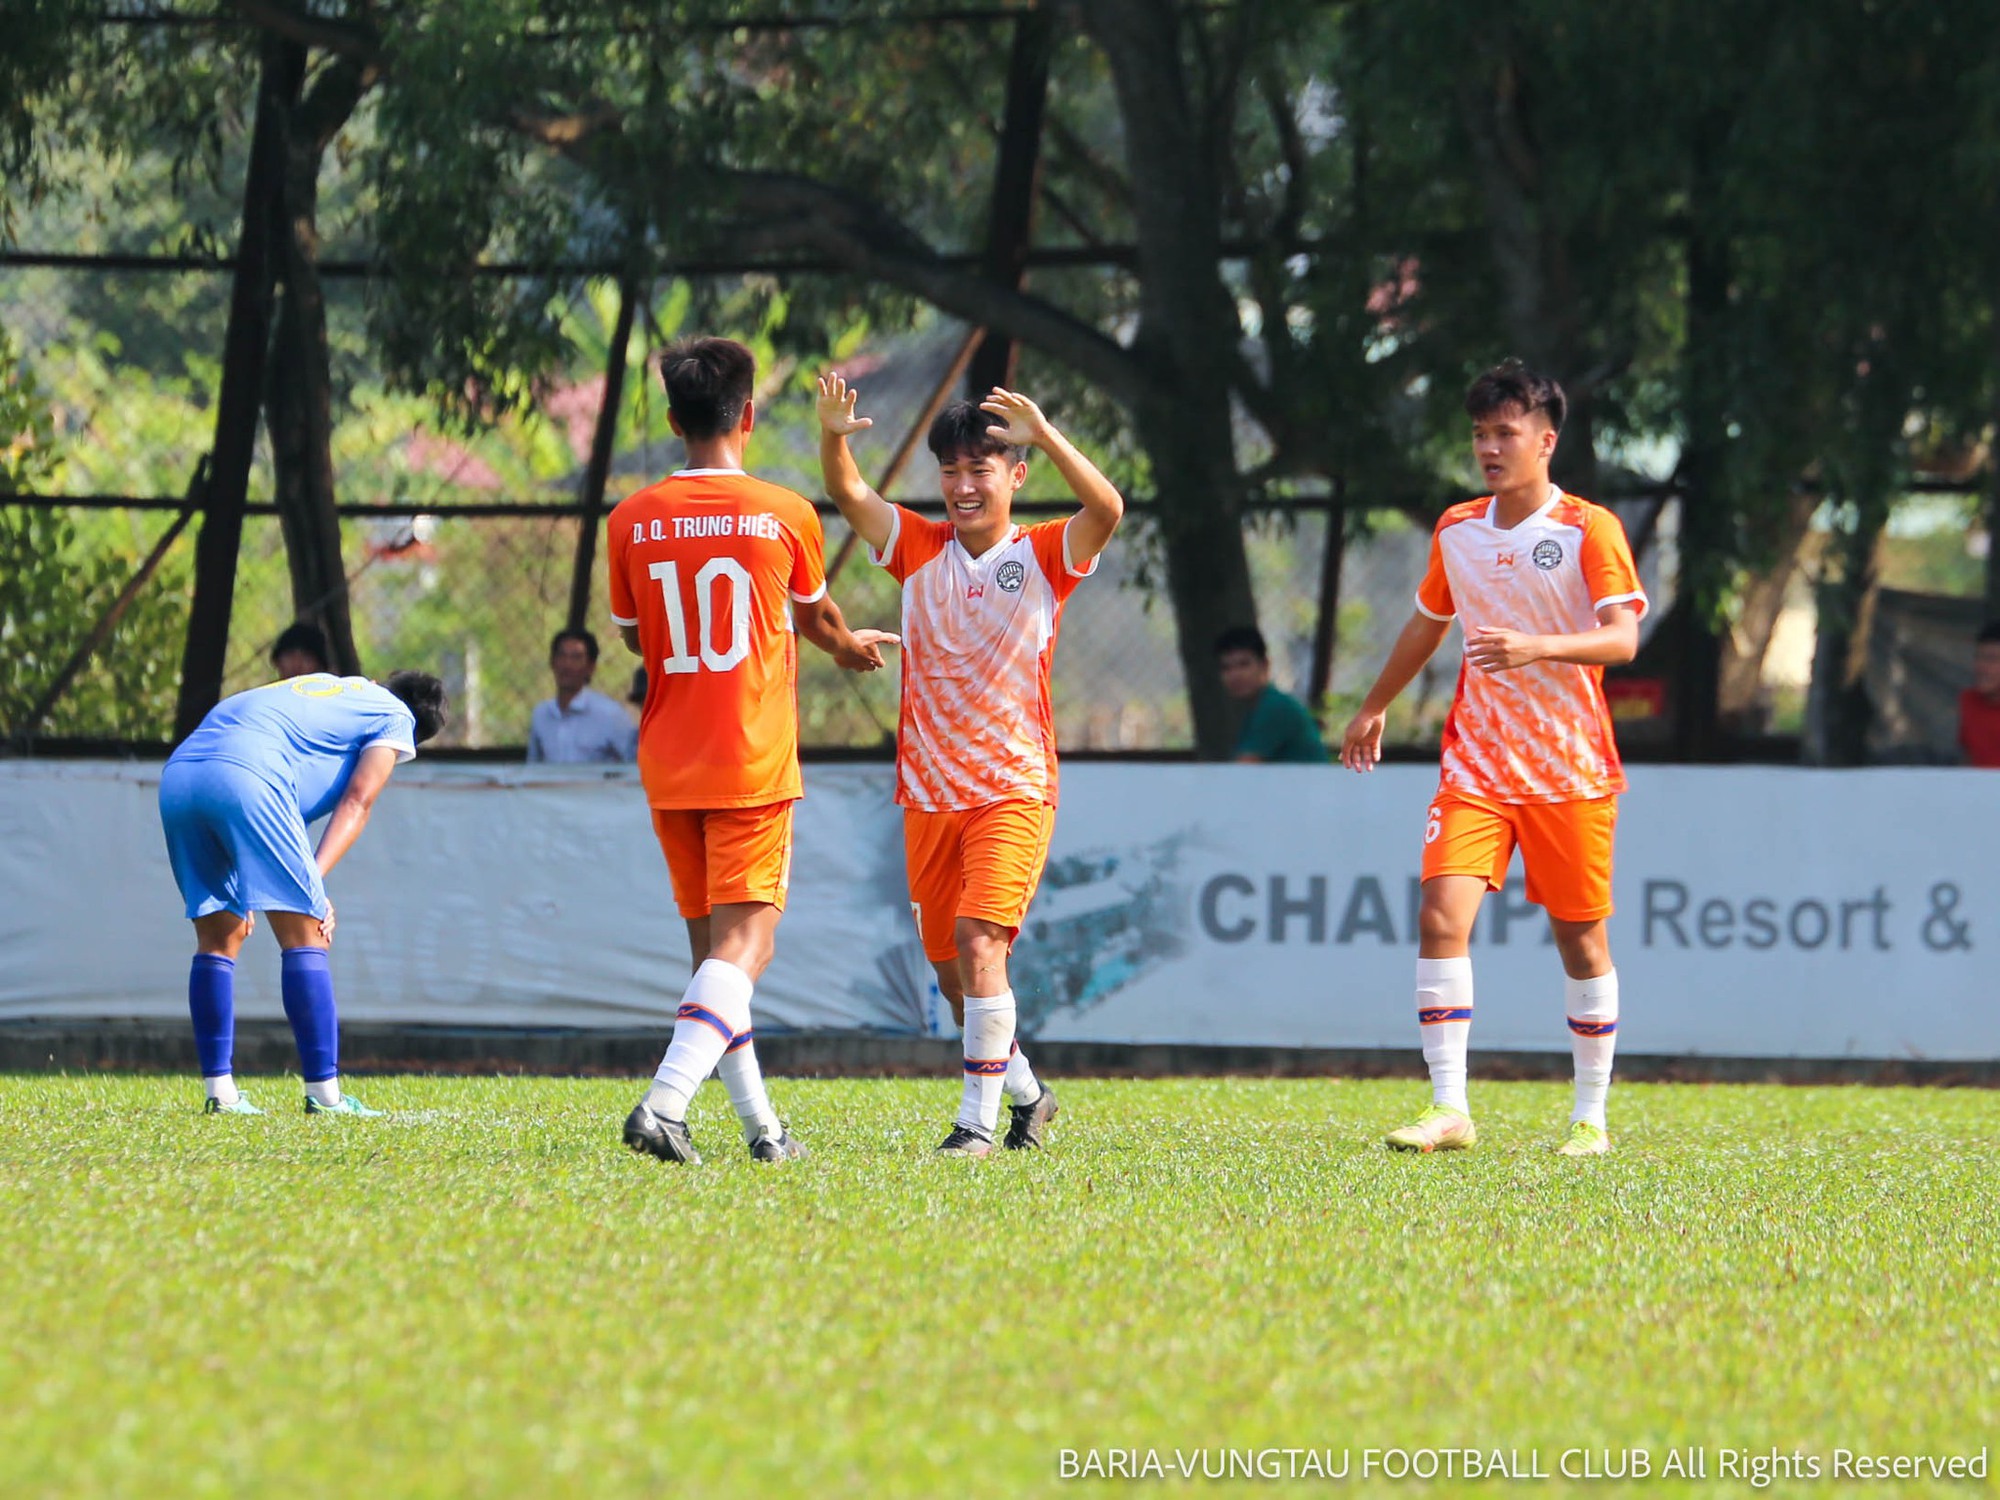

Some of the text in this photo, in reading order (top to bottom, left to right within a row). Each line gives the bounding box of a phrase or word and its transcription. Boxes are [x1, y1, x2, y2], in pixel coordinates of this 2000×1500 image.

[633, 523, 646, 544] D.
[650, 519, 667, 541] Q.
[672, 515, 733, 539] TRUNG
[648, 557, 751, 675] 10
[1199, 873, 1972, 951] CHAP Resort &
